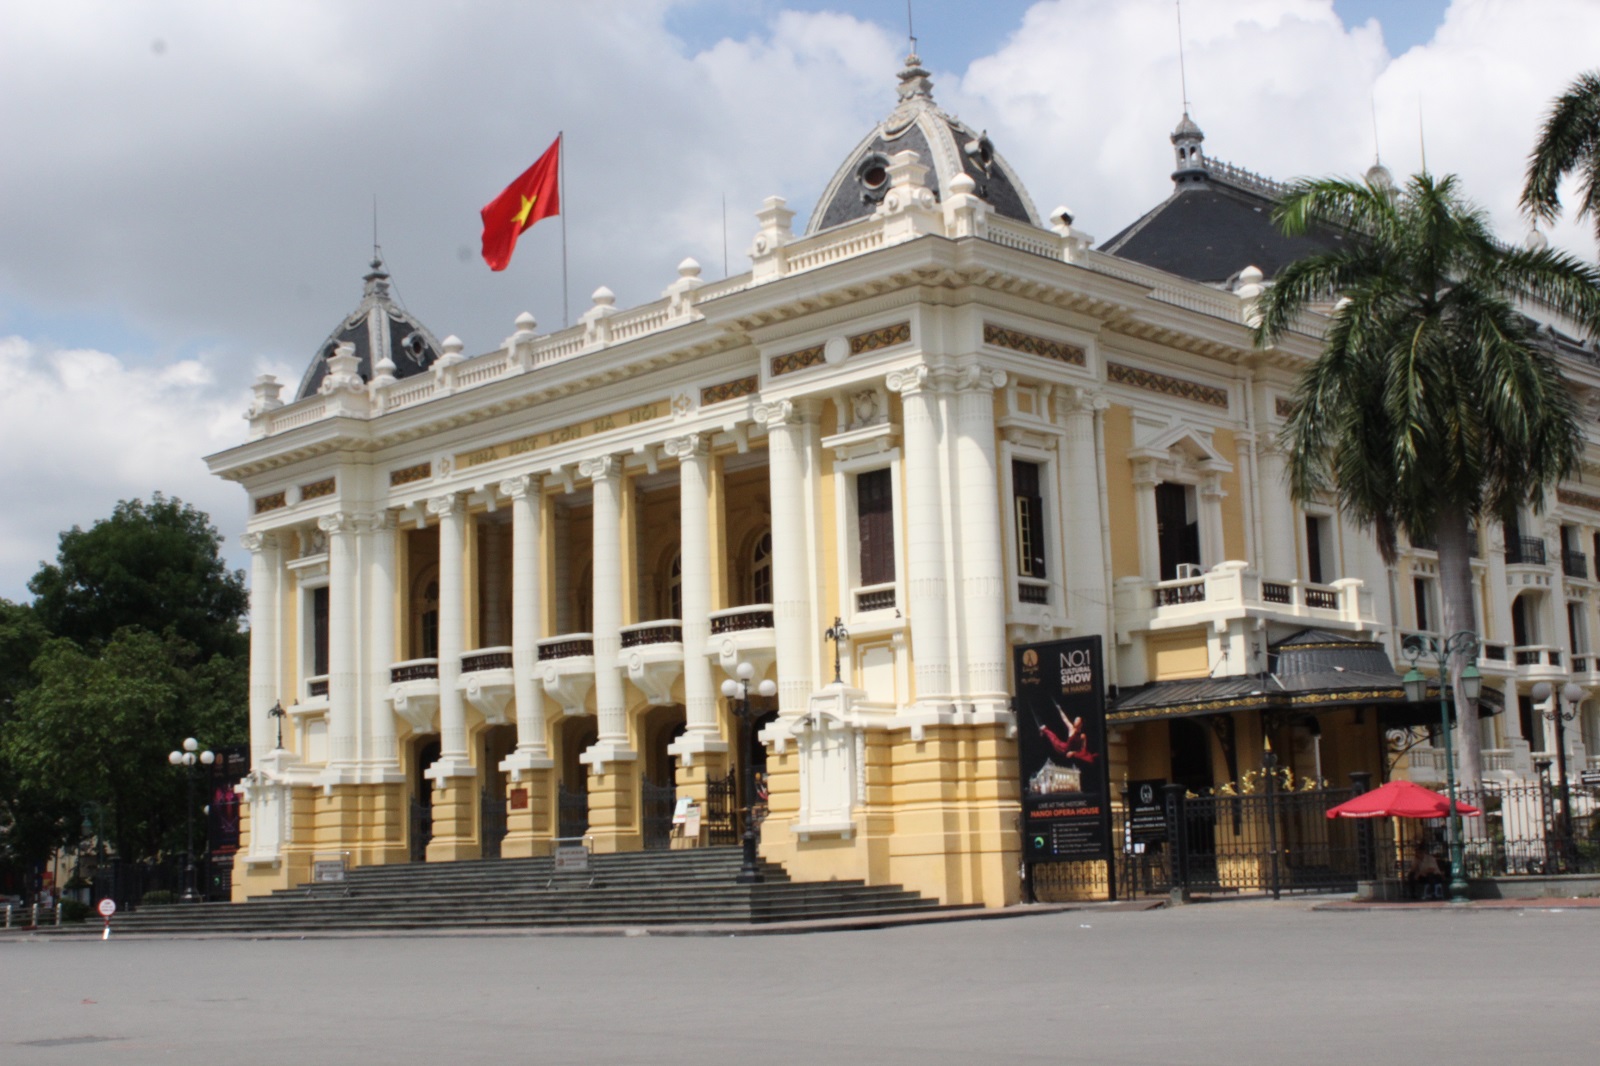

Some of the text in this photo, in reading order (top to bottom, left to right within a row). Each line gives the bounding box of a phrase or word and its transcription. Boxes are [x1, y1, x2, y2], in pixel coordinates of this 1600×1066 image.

[1060, 665, 1091, 675] CULTURAL
[1061, 672, 1092, 685] SHOW
[1030, 806, 1099, 818] HANOI OPERA HOUSE
